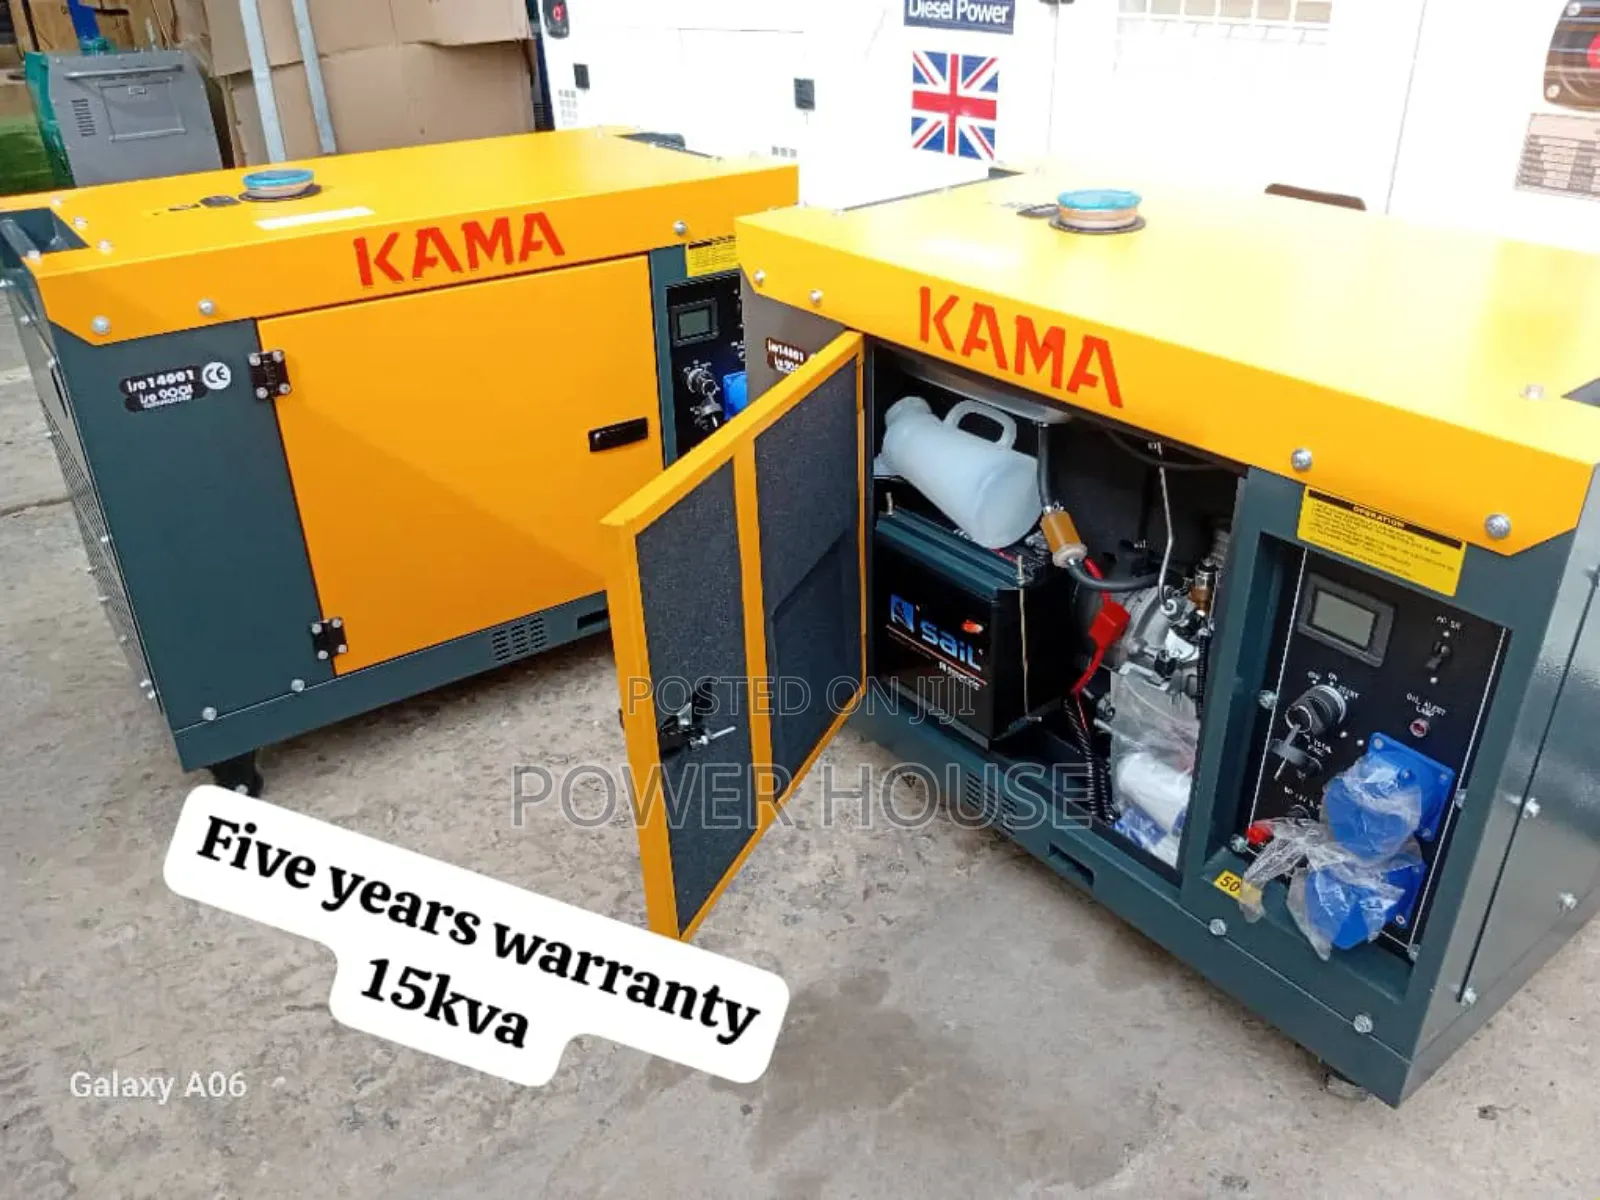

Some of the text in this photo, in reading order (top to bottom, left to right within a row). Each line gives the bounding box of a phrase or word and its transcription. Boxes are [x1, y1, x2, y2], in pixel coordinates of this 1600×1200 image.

[908, 0, 1010, 24] Diesel Power
[353, 212, 566, 287] KAMA
[919, 286, 1124, 408] KAMA
